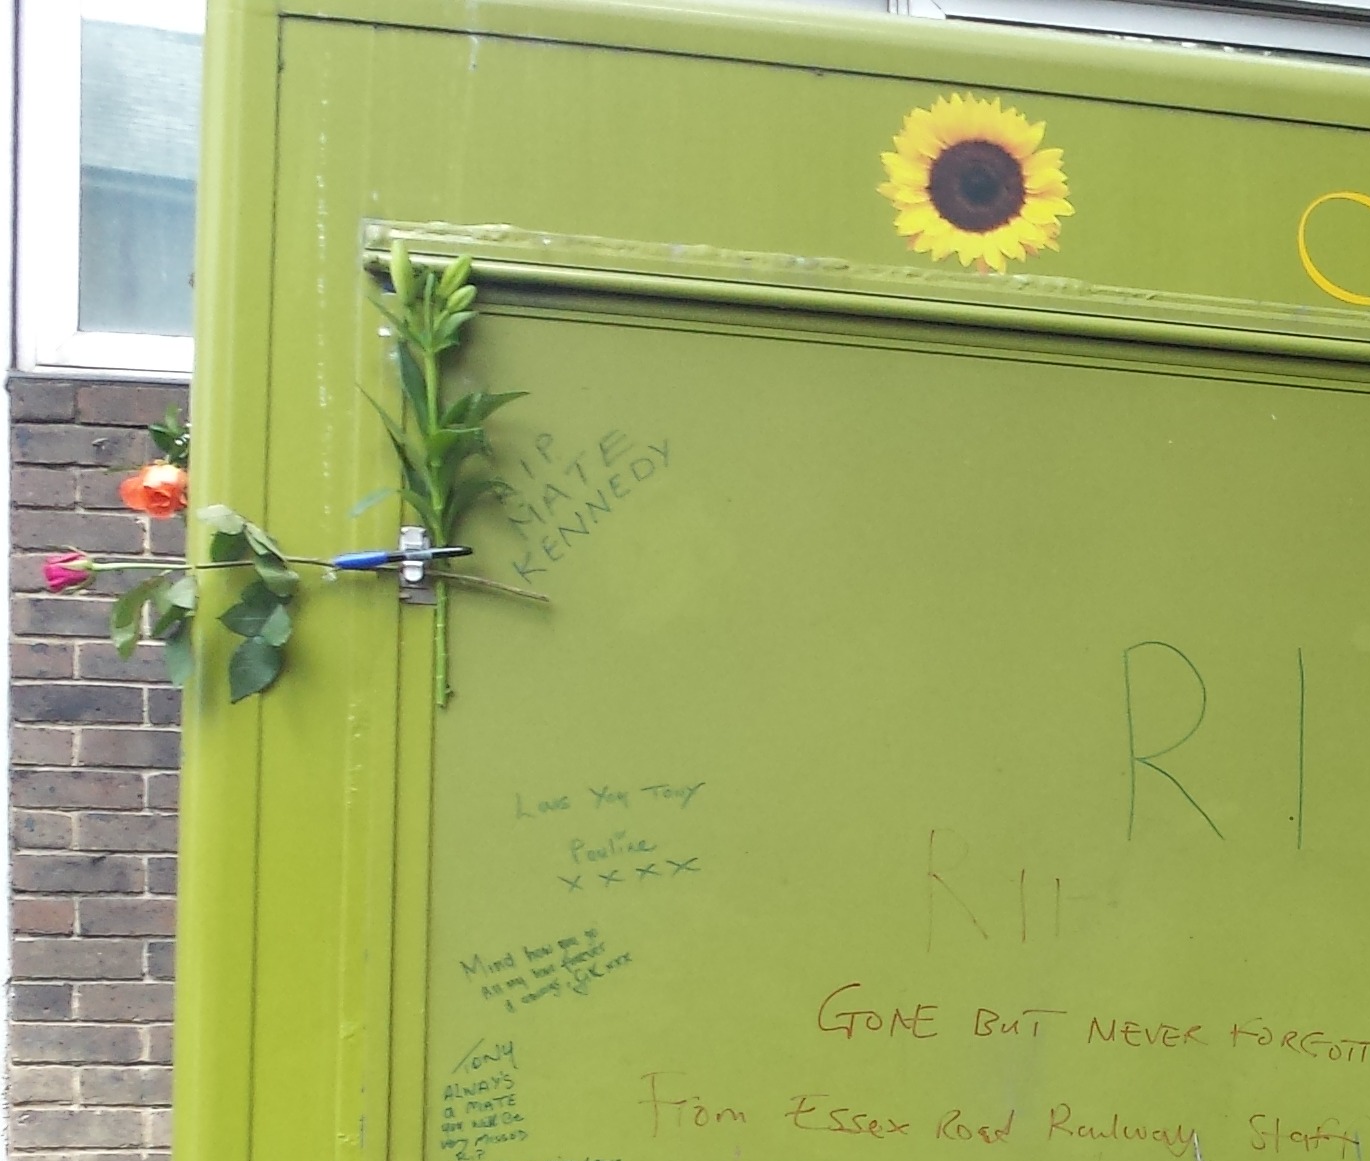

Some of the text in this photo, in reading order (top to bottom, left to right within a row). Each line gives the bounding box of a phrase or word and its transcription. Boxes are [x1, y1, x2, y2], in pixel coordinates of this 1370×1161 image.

[512, 438, 670, 585] KENNEDY
[818, 982, 940, 1042] GONE
[1088, 1015, 1208, 1047] NEVER
[784, 1091, 911, 1139] Essex
[936, 1109, 1015, 1148] Road
